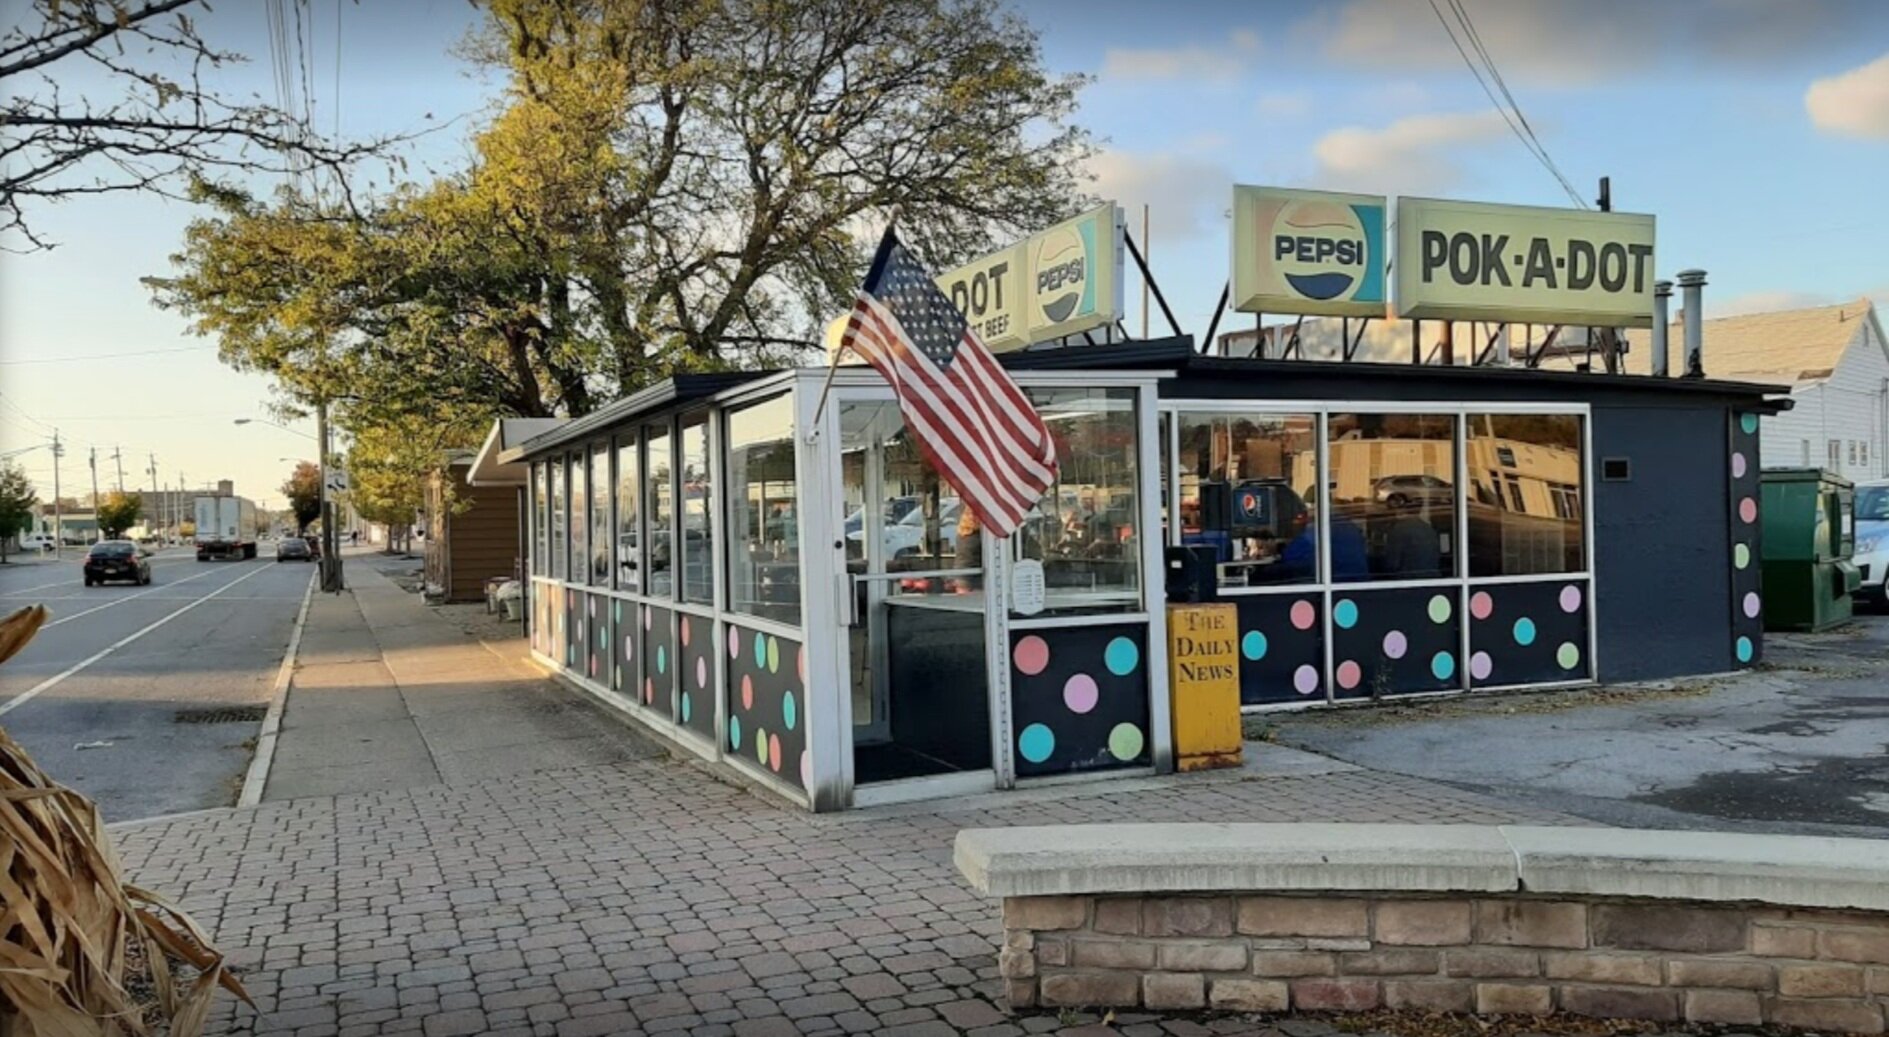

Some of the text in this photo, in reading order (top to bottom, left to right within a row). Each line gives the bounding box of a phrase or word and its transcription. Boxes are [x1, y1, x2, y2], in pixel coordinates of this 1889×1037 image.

[1275, 235, 1363, 266] PEPSI
[1037, 256, 1085, 295] PEPSI
[984, 313, 1010, 339] BEEF
[1183, 611, 1225, 631] THE
[1176, 637, 1235, 657] DAILY
[1179, 662, 1233, 683] NEWS
